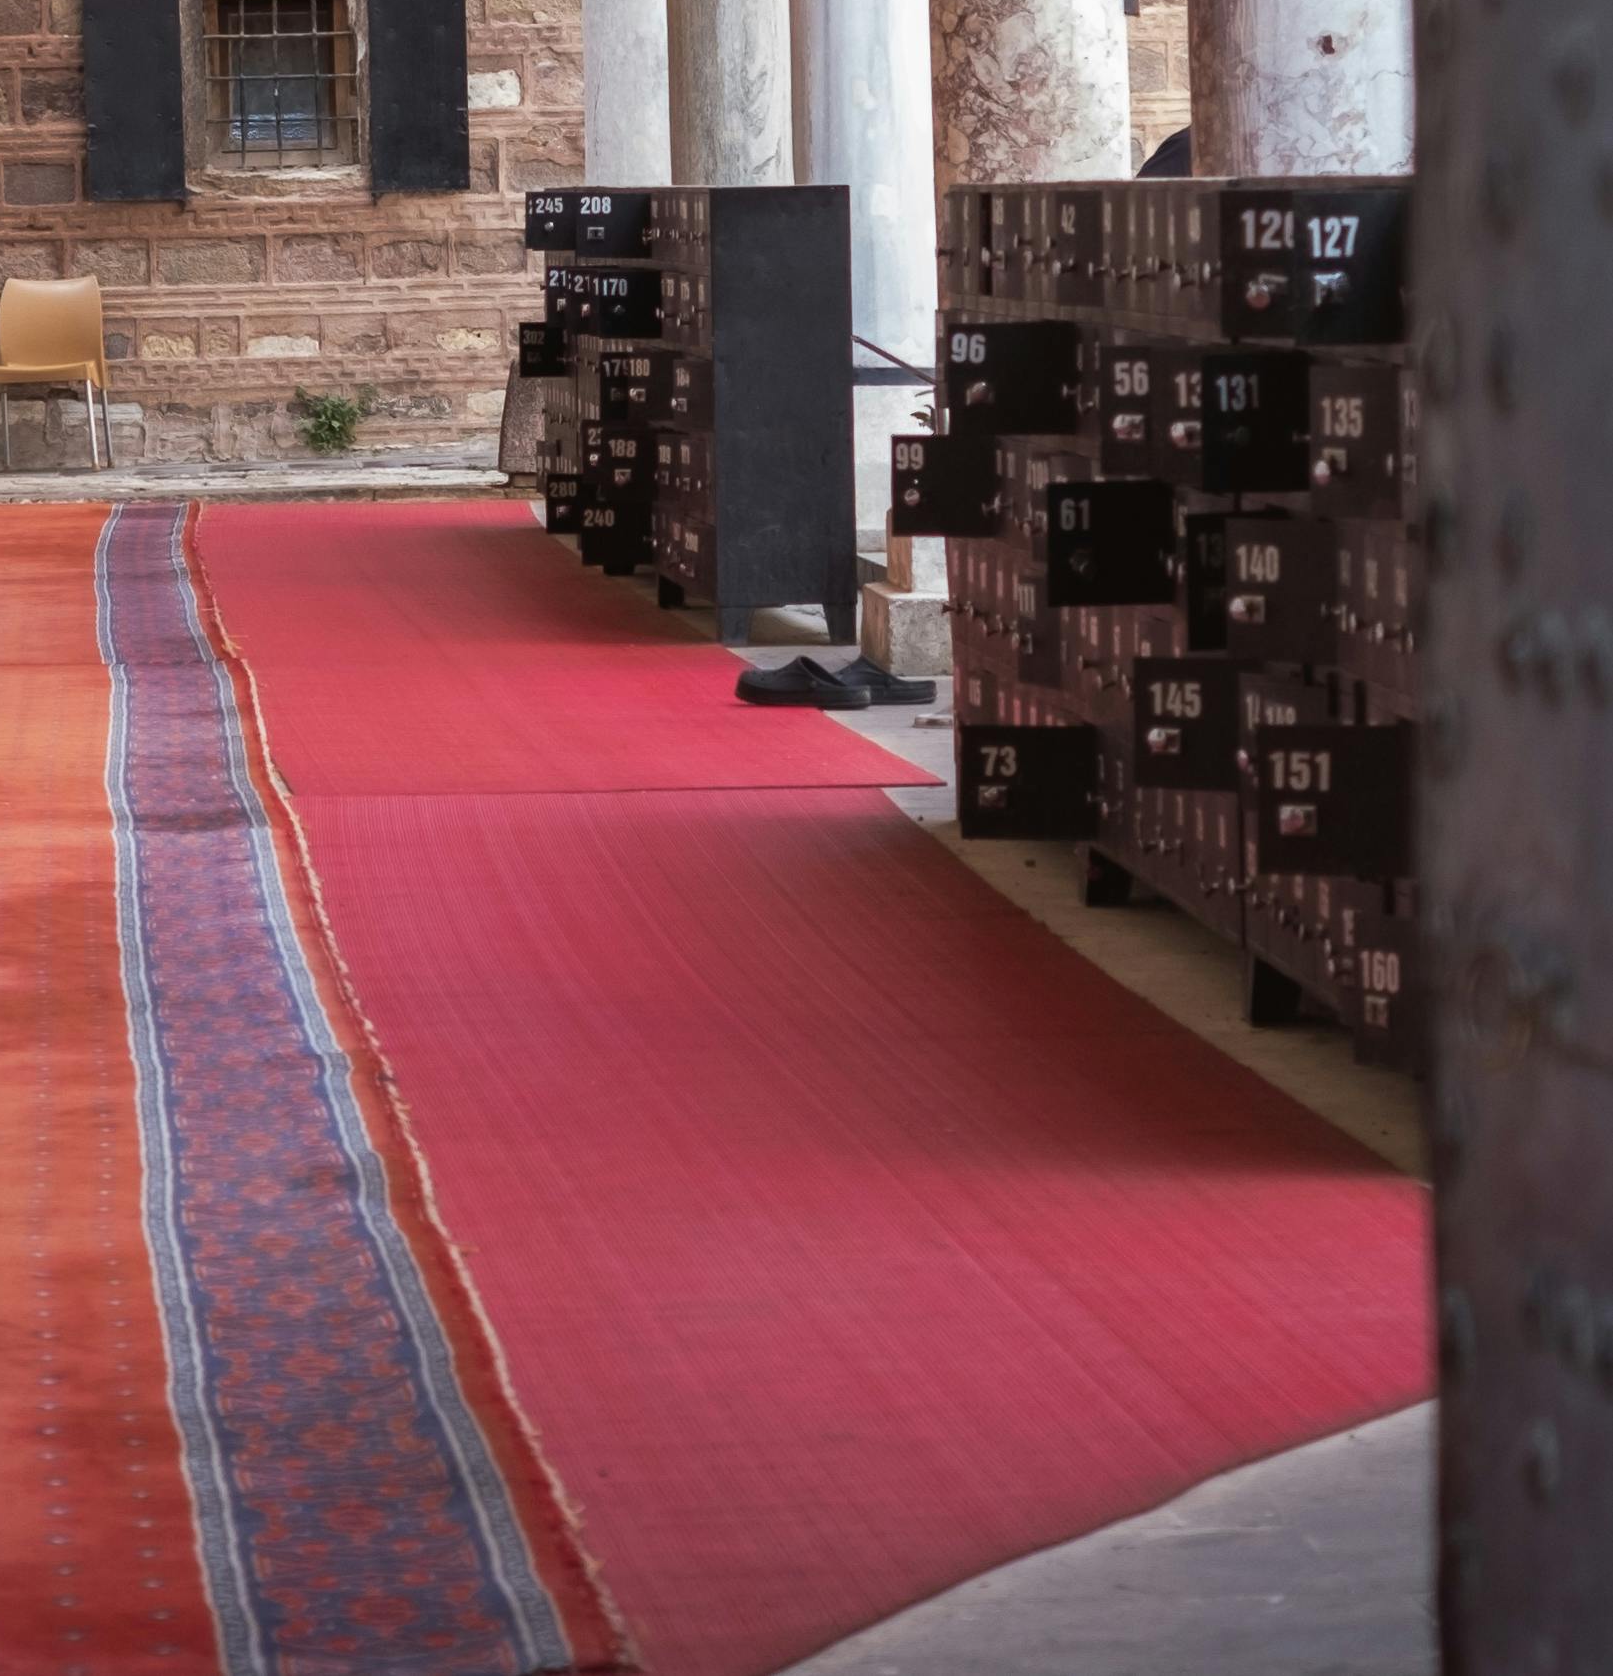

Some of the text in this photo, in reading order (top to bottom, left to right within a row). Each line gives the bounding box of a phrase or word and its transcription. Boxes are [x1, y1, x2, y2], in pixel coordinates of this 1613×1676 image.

[535, 197, 563, 214] 245
[580, 196, 612, 215] 208
[1307, 216, 1360, 258] 127
[950, 332, 986, 364] 96
[628, 358, 650, 378] 180
[1113, 361, 1150, 397] 56
[1215, 373, 1260, 413] 131
[1321, 396, 1364, 438] 135
[607, 439, 637, 458] 188
[895, 444, 923, 470] 99
[549, 481, 577, 498] 280
[583, 509, 615, 527] 240
[1059, 498, 1091, 532] 61
[1235, 544, 1280, 584] 140
[1149, 682, 1203, 719] 145
[980, 745, 1018, 777] 73
[1268, 751, 1331, 793] 151
[1360, 950, 1400, 994] 160
